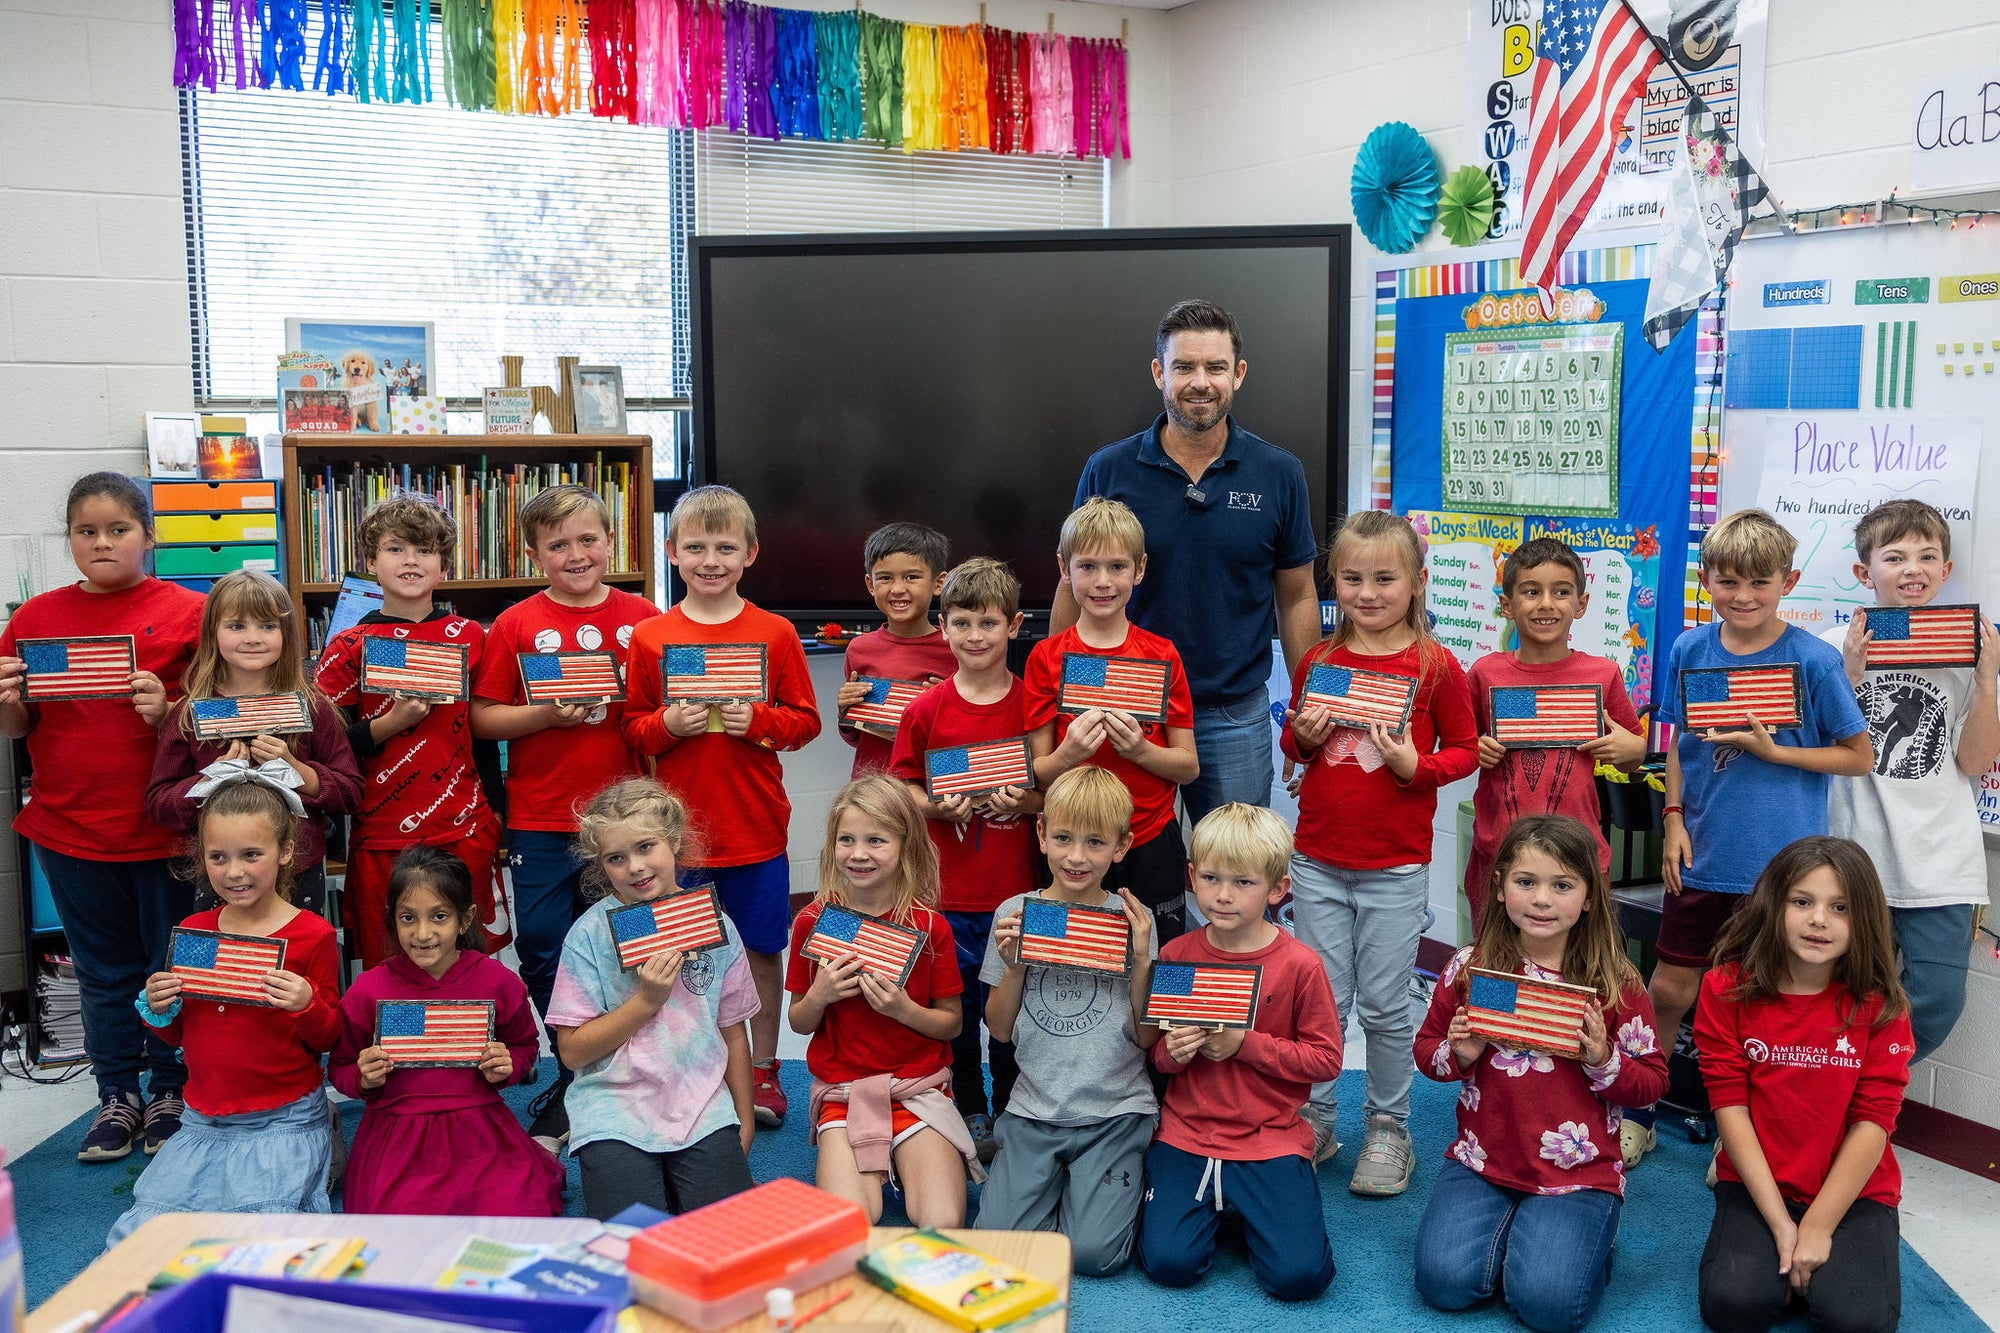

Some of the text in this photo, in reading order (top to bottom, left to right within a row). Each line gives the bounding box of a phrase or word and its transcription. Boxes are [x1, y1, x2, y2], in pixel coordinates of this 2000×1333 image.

[1647, 87, 1673, 107] My
[1722, 77, 1733, 91] is
[1648, 117, 1684, 136] blac
[1645, 149, 1676, 167] larg
[1613, 160, 1637, 176] word
[1638, 200, 1658, 215] end
[1768, 285, 1825, 302] Hundreds
[1876, 284, 1908, 299] Tens
[1960, 280, 1998, 296] Ones
[1482, 298, 1587, 320] Octoer
[1458, 362, 1464, 377] 1
[1478, 360, 1485, 376] 2
[1522, 360, 1530, 374] 4
[1545, 357, 1554, 373] 5
[1568, 358, 1577, 374] 6
[1590, 357, 1600, 373] 7
[1456, 388, 1605, 406] 8 9 10 11 12 13 14
[300, 422, 338, 430] SQUAD
[490, 415, 521, 424] FUTURE
[489, 425, 522, 433] BRIGHT!
[1452, 420, 1602, 437] 15 16 17 18 19 20 21
[1794, 421, 1948, 475] Place Value
[1453, 449, 1604, 468] 22 23 24 25 26 27 28
[1449, 479, 1504, 496] 29 30 31
[1775, 496, 1801, 514] two
[1808, 497, 1870, 515] hundred
[1431, 516, 1466, 541] Days
[1478, 518, 1518, 540] Week
[1586, 528, 1596, 538] of
[1585, 538, 1599, 548] the
[1597, 527, 1636, 549] Year
[1433, 555, 1466, 571] Sunday
[1607, 559, 1622, 568] Jan.
[1432, 575, 1466, 591] Monday
[1606, 575, 1622, 584] Feb.
[1432, 594, 1468, 611] Tuesday
[1606, 590, 1622, 600] Mar.
[1605, 606, 1620, 616] Apr.
[1604, 622, 1619, 633] May
[1440, 635, 1472, 651] ursday
[1604, 638, 1621, 647] June
[1876, 673, 1940, 696] AMERICAN
[1932, 726, 1945, 761] 2022
[377, 739, 427, 784] Champion
[1055, 990, 1082, 1001] 1979
[1036, 1009, 1103, 1032] GEORGIA
[1772, 1045, 1828, 1055] AMERICAN
[1771, 1053, 1861, 1068] HERITAGE GIRLS
